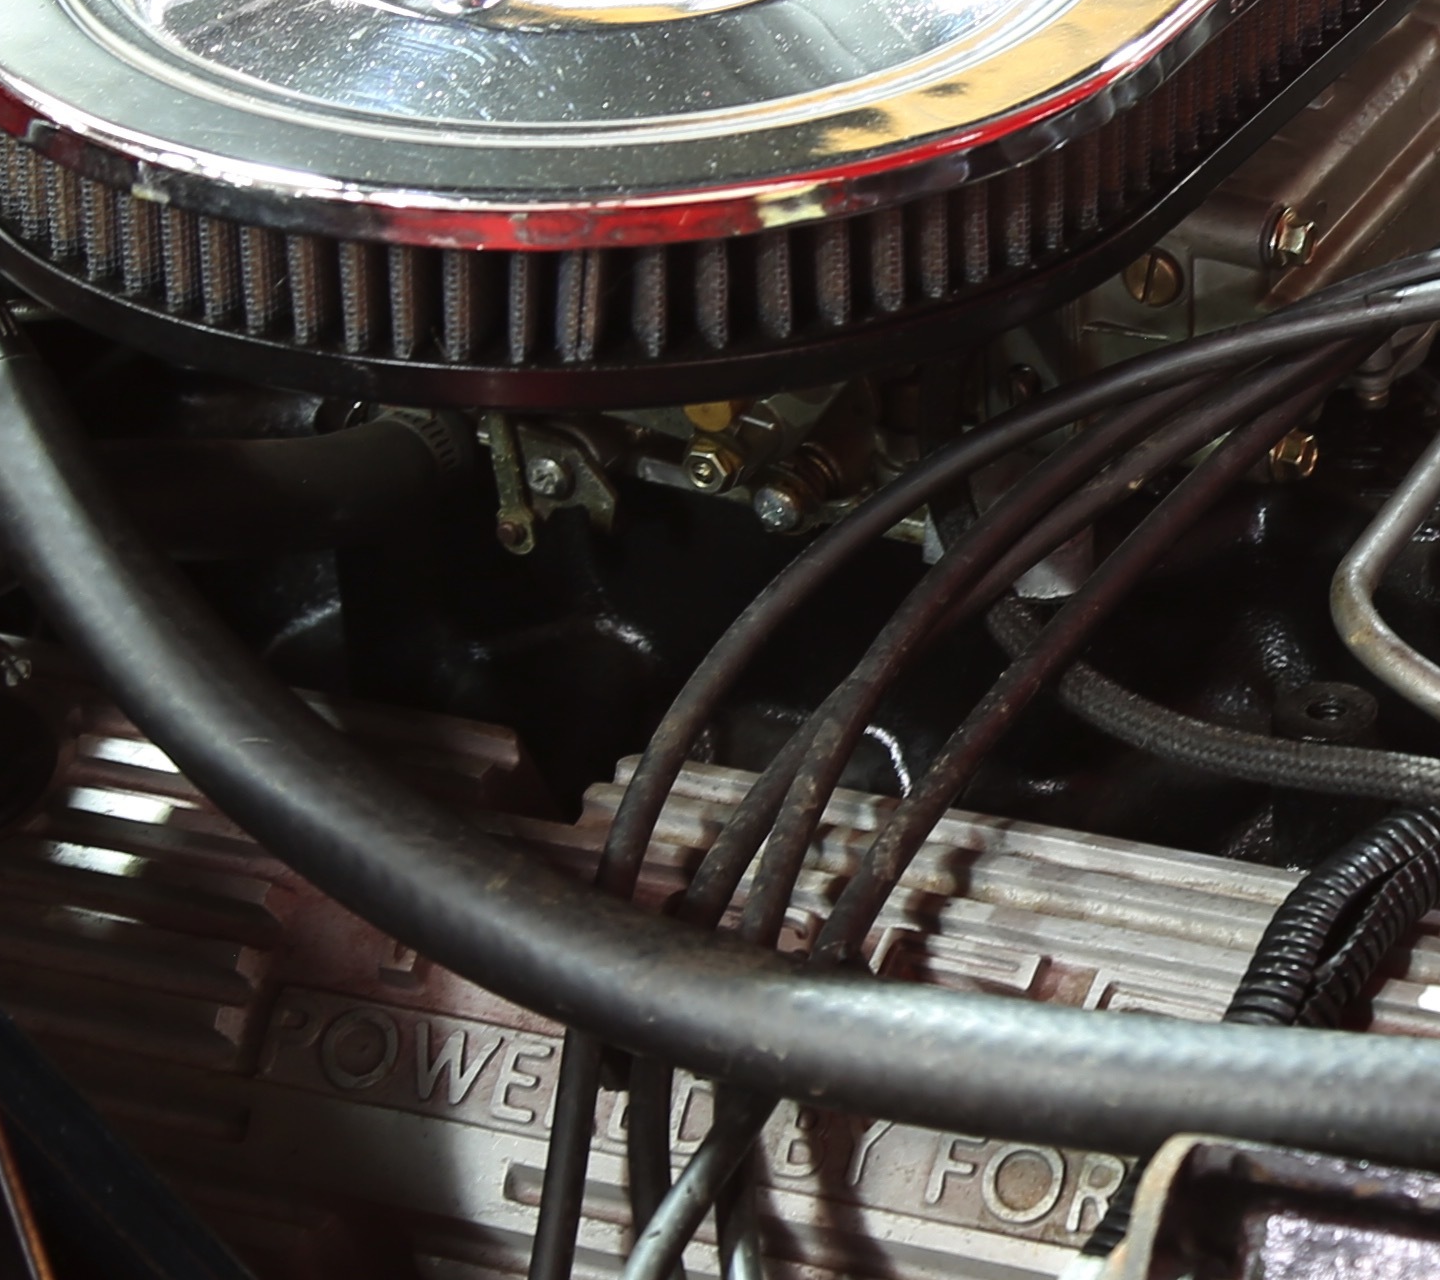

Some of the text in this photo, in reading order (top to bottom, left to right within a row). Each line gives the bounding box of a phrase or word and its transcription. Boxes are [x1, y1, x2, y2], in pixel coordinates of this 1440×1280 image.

[256, 994, 1128, 1233] POWED BY FOR
